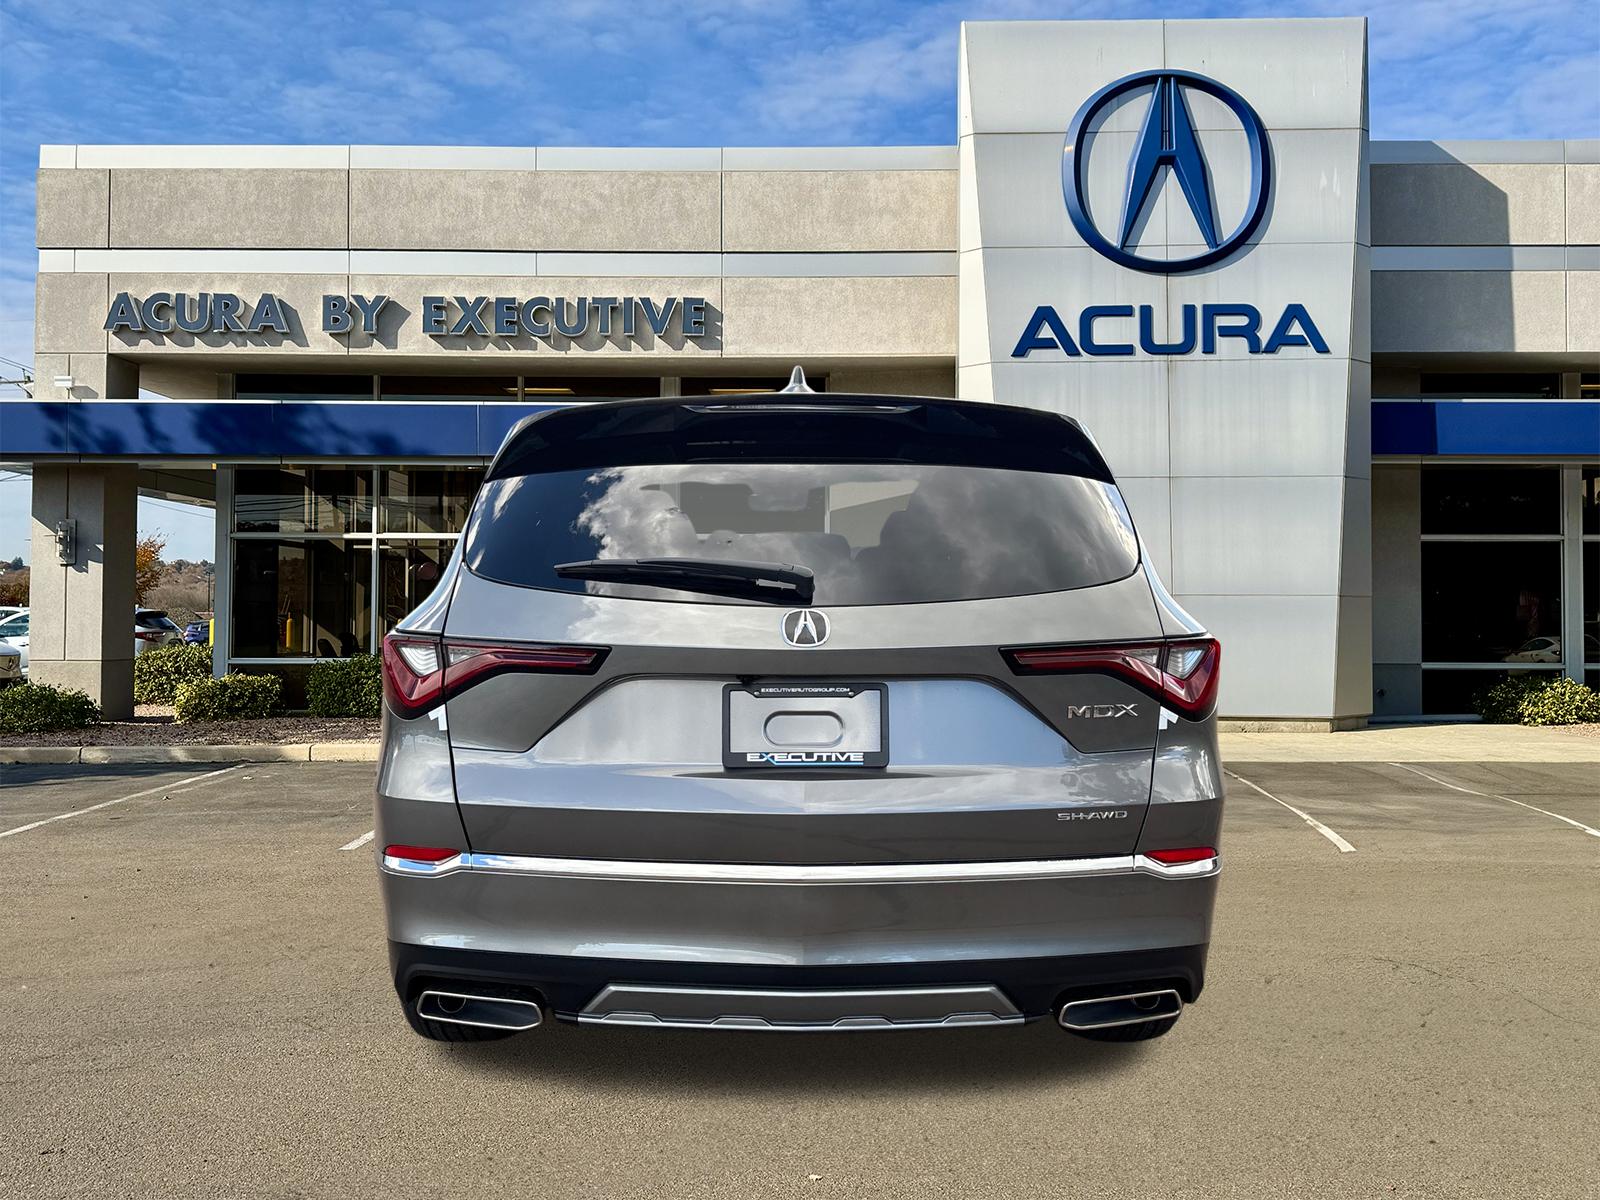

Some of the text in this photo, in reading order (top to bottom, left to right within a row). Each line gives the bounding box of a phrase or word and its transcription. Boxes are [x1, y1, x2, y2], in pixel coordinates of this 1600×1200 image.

[104, 291, 707, 337] ACURA BY EXECUTIVE
[1011, 303, 1331, 357] ACURA
[1067, 703, 1138, 718] MDX
[746, 752, 864, 763] EXECUTIVE
